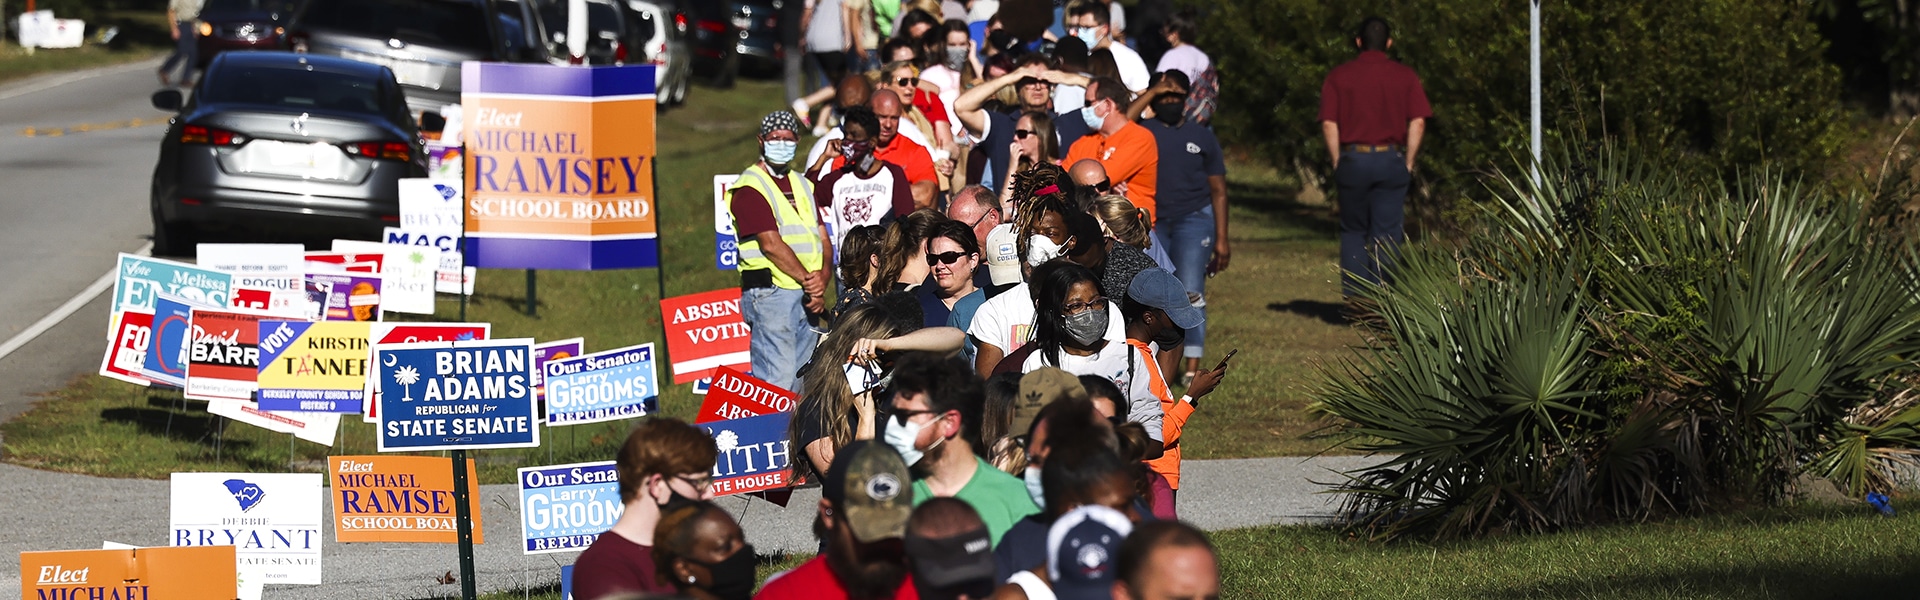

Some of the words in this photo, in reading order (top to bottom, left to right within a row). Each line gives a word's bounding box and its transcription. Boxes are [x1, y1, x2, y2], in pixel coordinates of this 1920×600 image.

[475, 108, 523, 127] Elect
[473, 130, 584, 154] MICHAEL
[472, 155, 645, 196] RAMSEY
[470, 198, 567, 219] SCHOOL
[572, 199, 649, 220] BOARD
[124, 260, 152, 277] Vote
[172, 269, 227, 292] Melissa
[672, 298, 741, 325] ABSEN
[192, 324, 240, 346] David
[260, 322, 295, 355] VOTE
[190, 343, 260, 367] BARR
[435, 349, 524, 375] BRIAN
[549, 361, 583, 376] Our
[585, 350, 648, 372] Senator
[423, 374, 527, 401] ADAMS
[569, 372, 609, 387] Larry
[549, 375, 648, 409] GROOMS
[415, 404, 480, 415] REPUBLICAN
[482, 404, 498, 414] for
[387, 419, 447, 437] STATE
[452, 416, 528, 436] SENATE
[338, 460, 374, 473] Elect
[339, 474, 421, 488] MICHAEL
[526, 470, 567, 488] Our
[570, 468, 618, 485] Sena
[735, 473, 782, 490] HOUSE
[550, 488, 598, 503] Larry
[222, 517, 271, 526] DEBBIE
[526, 493, 625, 531] GROOM
[342, 516, 413, 530] SCHOOL
[175, 529, 318, 550] BRYANT
[271, 558, 318, 566] SENATE
[37, 566, 89, 583] Elect
[37, 586, 151, 600] MICHAEL
